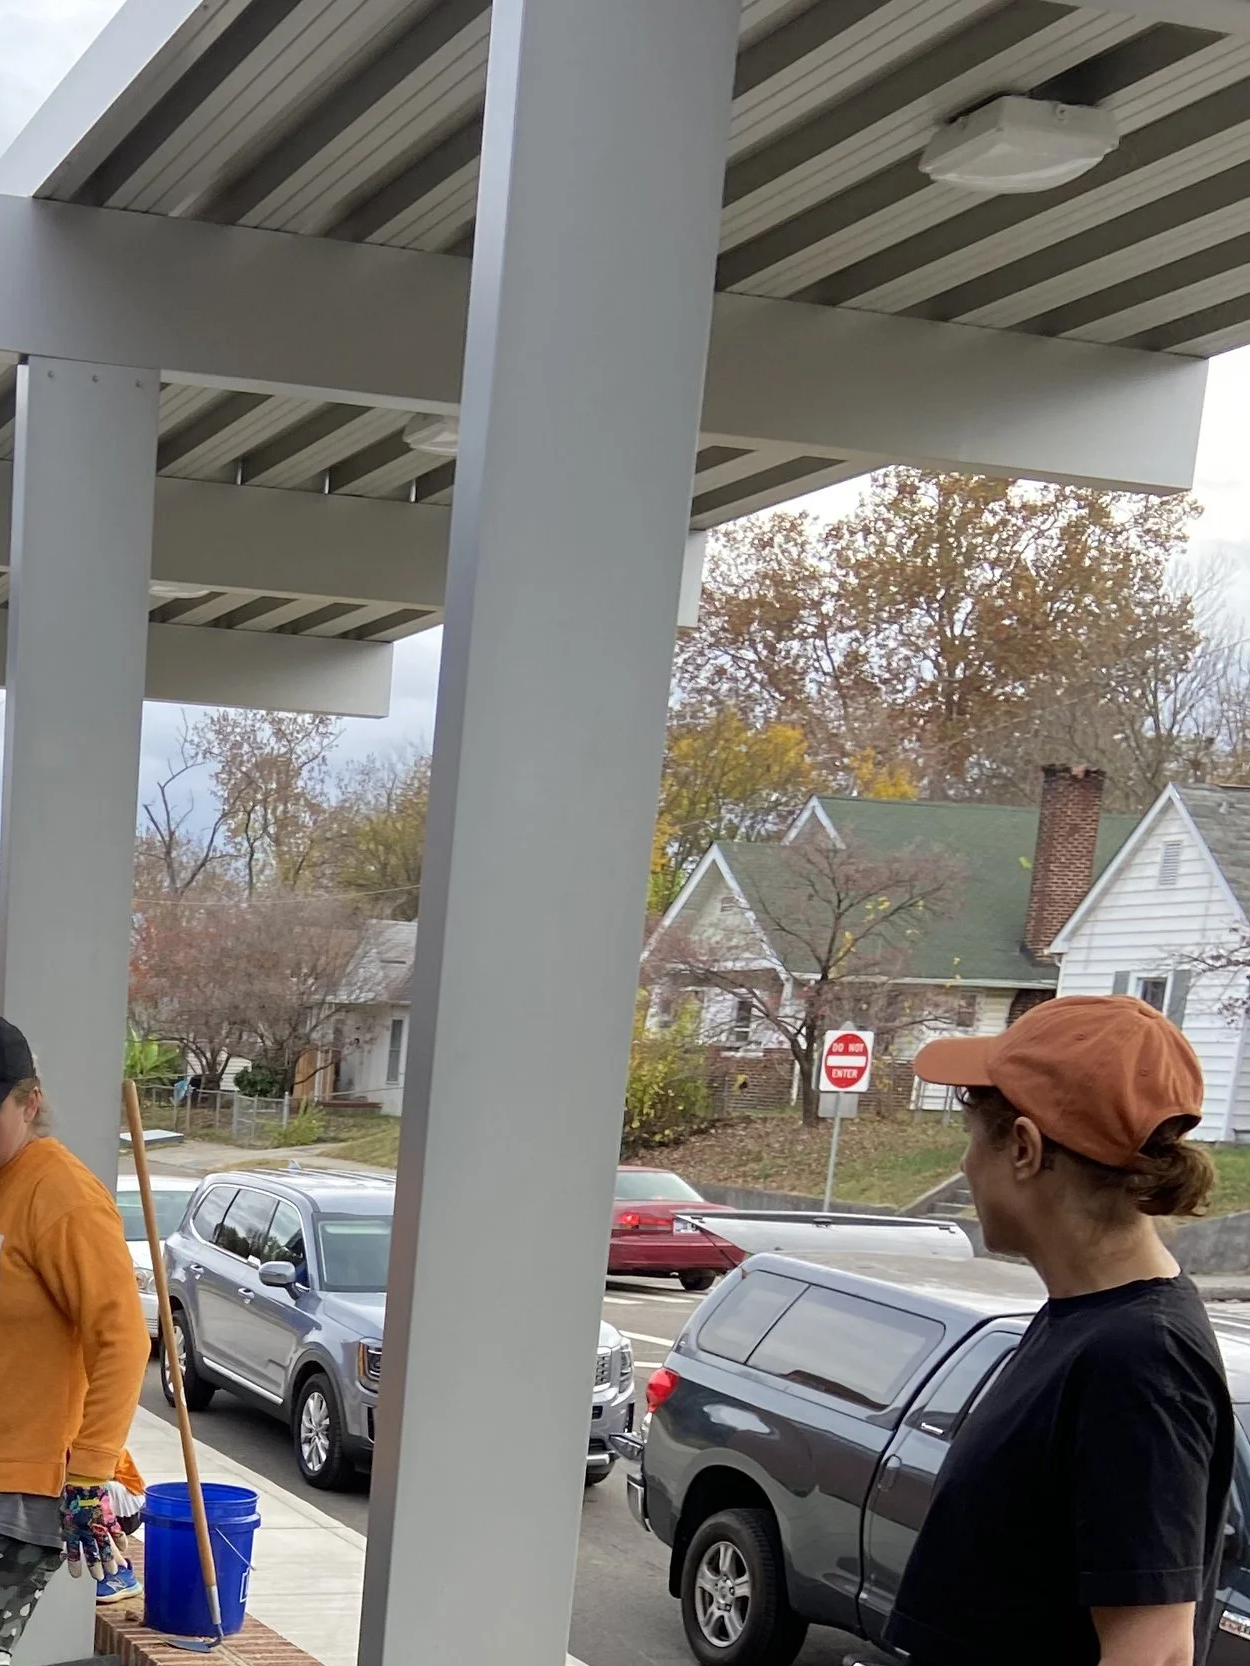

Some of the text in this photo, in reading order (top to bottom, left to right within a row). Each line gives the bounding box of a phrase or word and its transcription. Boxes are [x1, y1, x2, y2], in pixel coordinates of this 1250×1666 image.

[831, 1042, 865, 1053] DO NOT
[831, 1068, 858, 1078] ENTER
